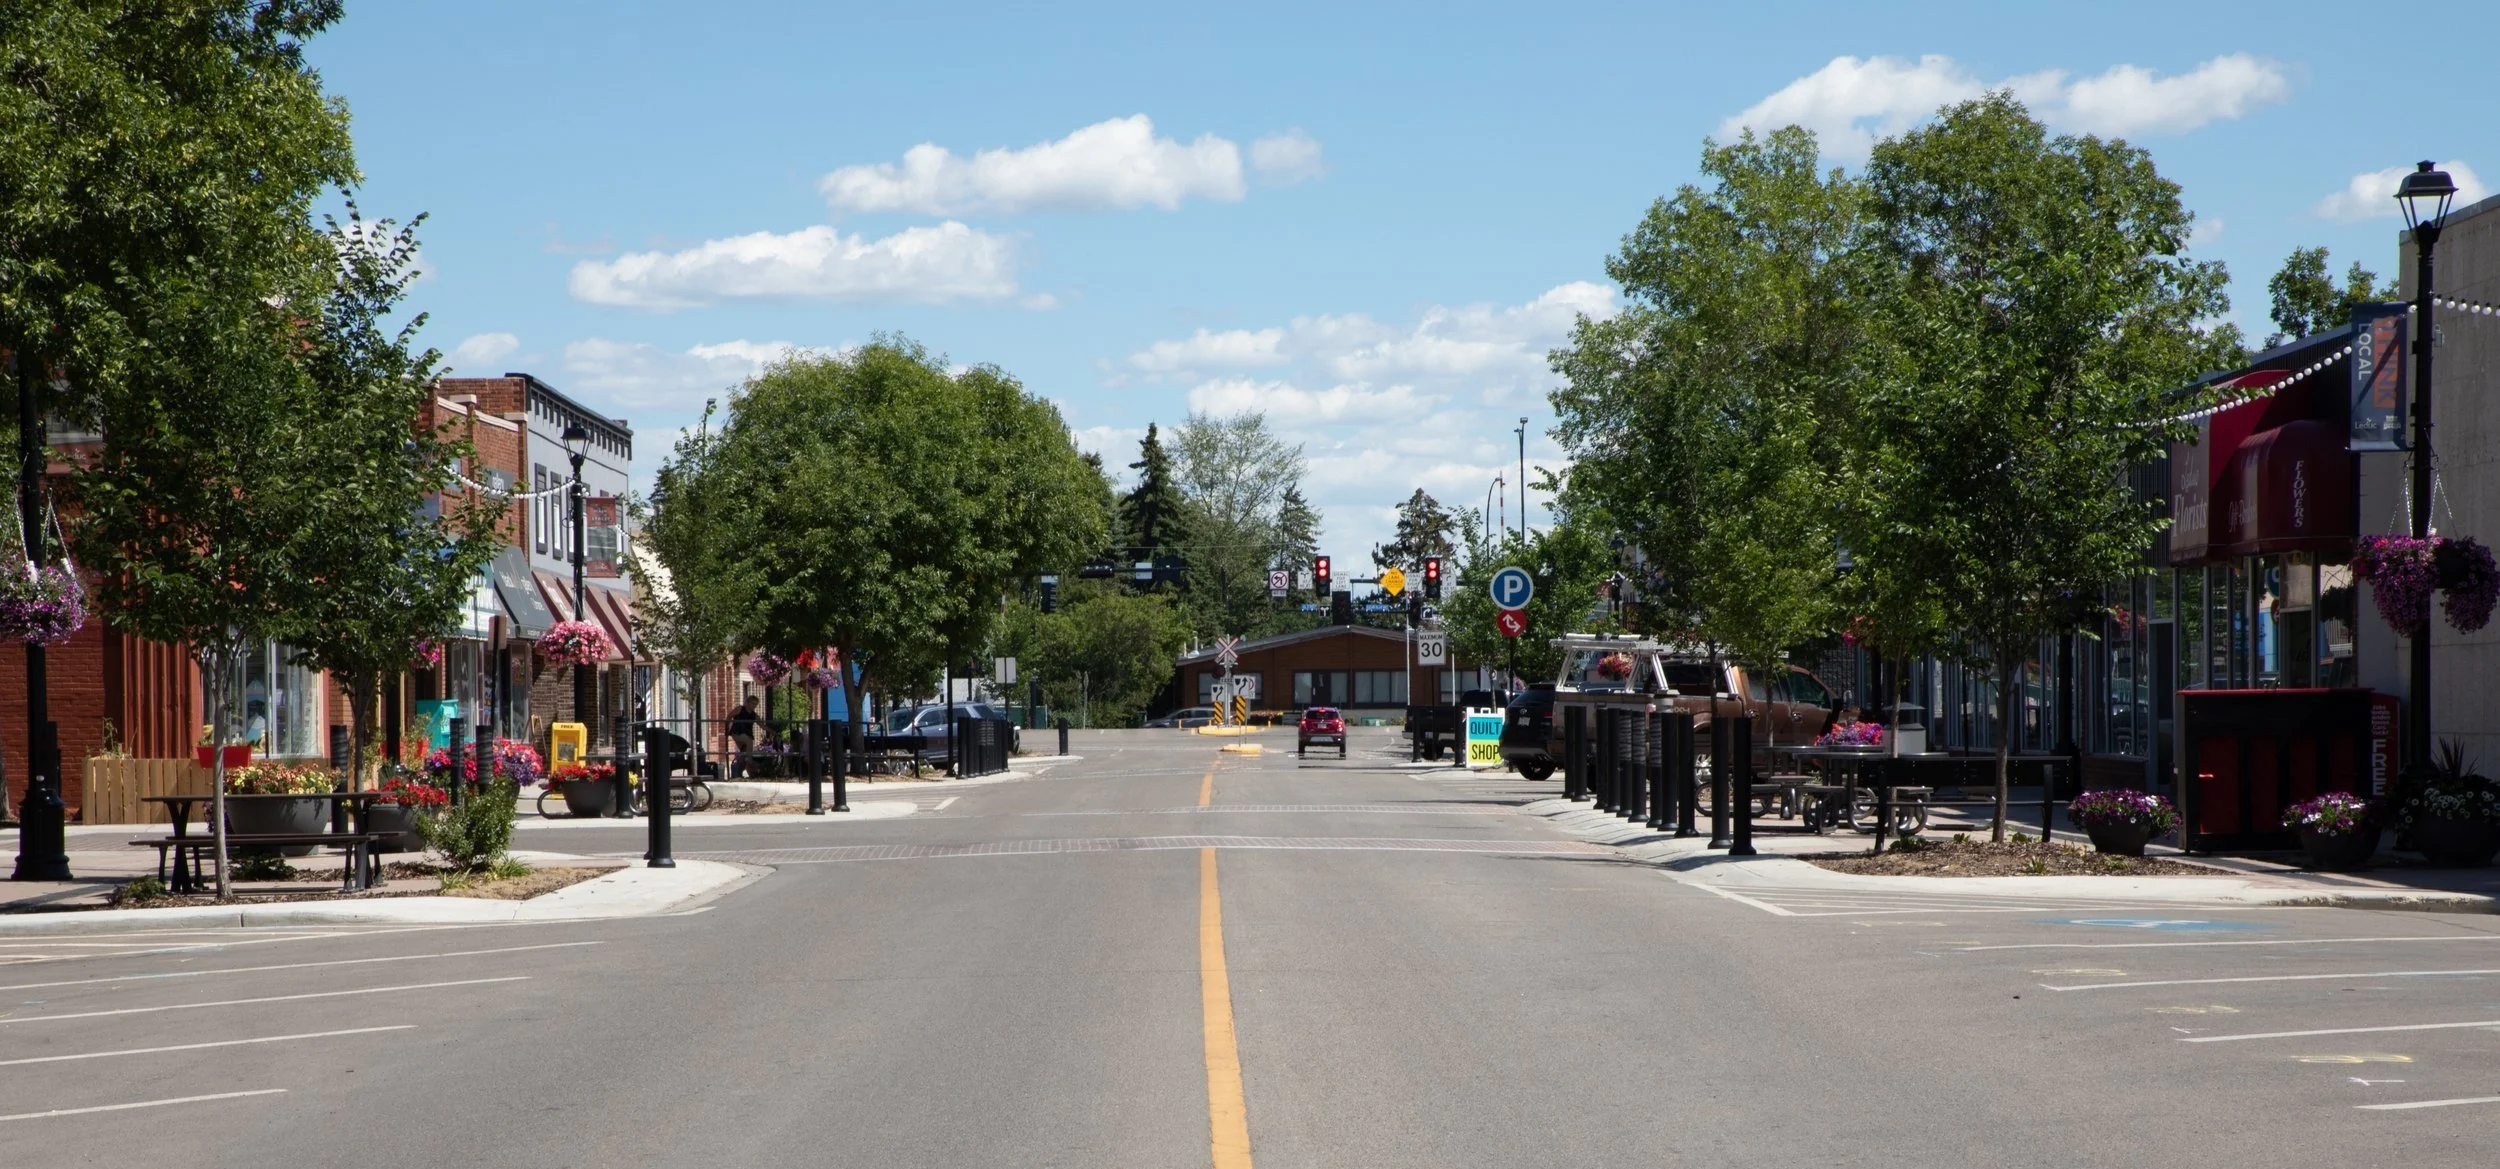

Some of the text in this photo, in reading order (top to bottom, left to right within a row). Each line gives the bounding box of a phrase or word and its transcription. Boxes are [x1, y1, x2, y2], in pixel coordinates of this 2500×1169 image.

[2358, 323, 2372, 381] LOCAL
[2293, 460, 2307, 528] FLOWERS
[2172, 494, 2208, 537] Florists
[1504, 575, 1523, 602] P
[1421, 642, 1443, 658] 30
[1470, 721, 1502, 735] QUILT
[1471, 744, 1500, 760] SHOP
[2371, 738, 2388, 796] FREE
